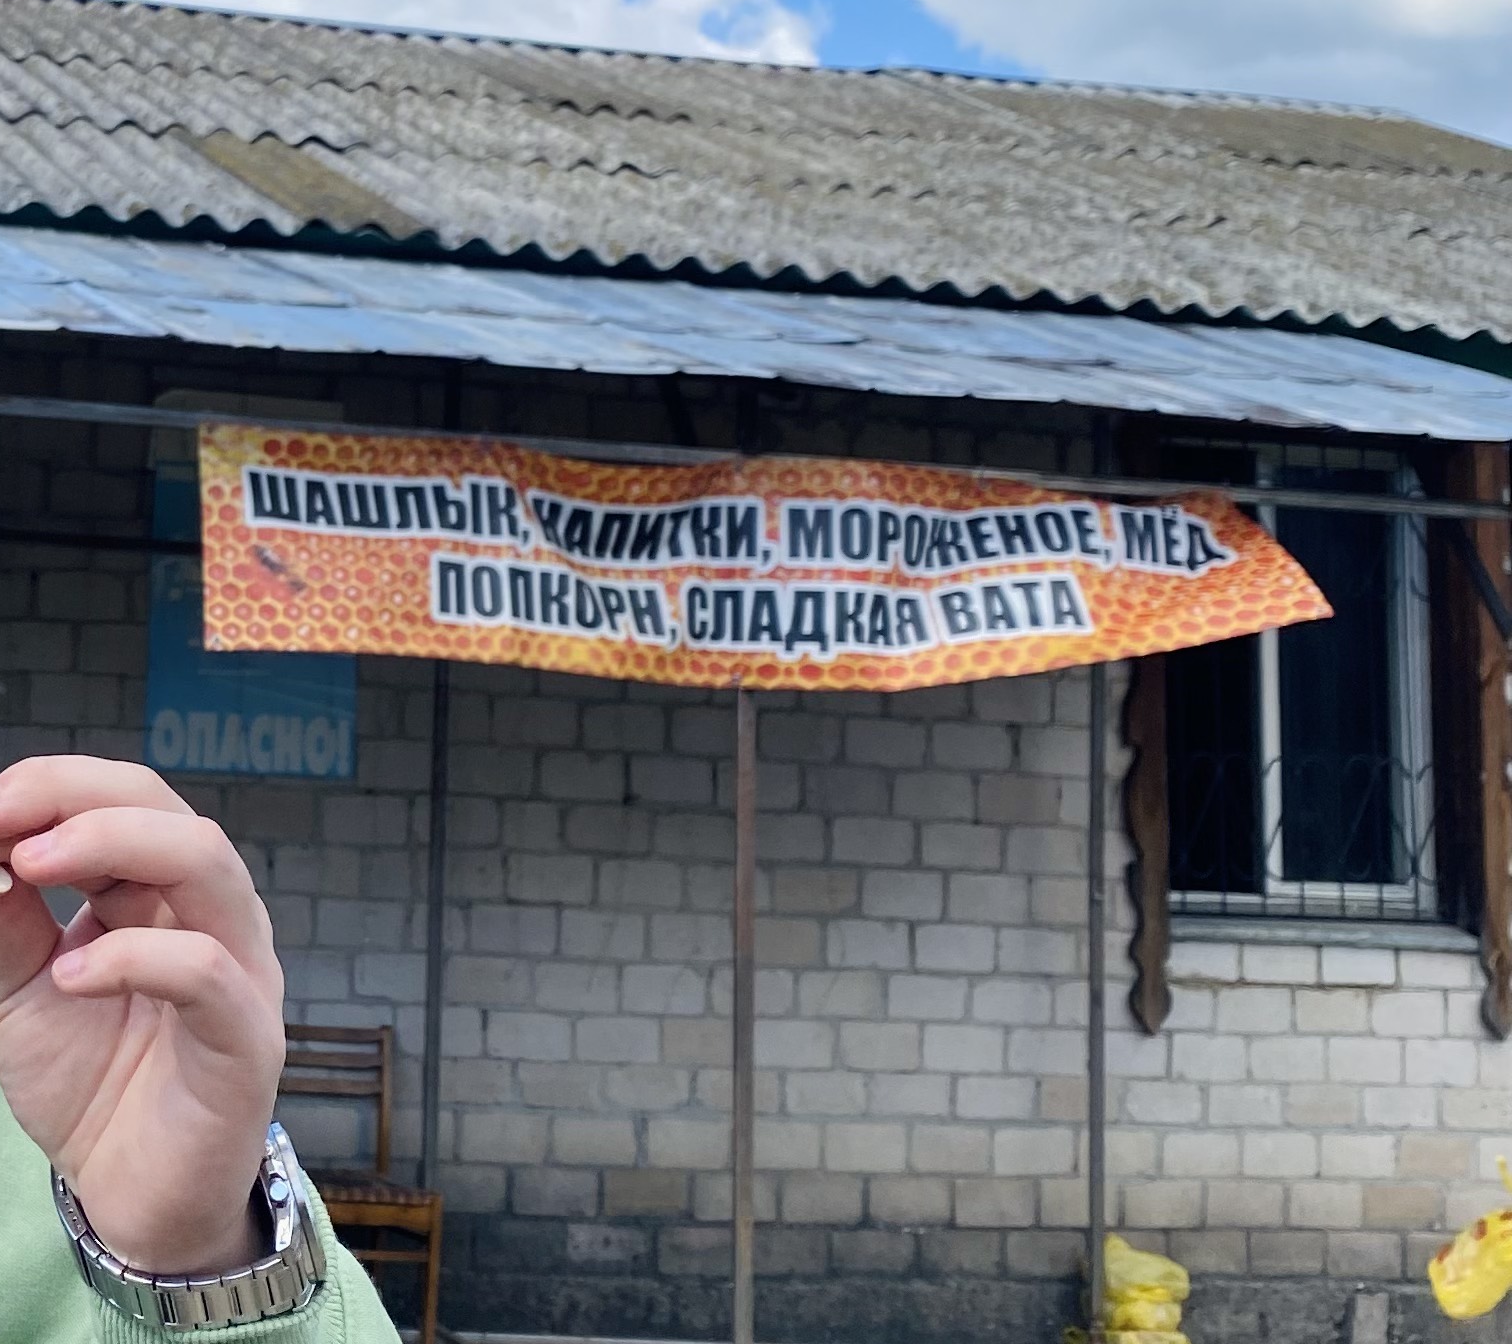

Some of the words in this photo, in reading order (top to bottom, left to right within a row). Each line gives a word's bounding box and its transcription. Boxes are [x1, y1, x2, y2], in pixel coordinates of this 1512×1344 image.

[247, 469, 531, 546] ШАШЛЫК,
[787, 506, 1113, 569] МОРОЖЕНОЕ,
[1119, 506, 1229, 571] МЁД
[436, 560, 677, 643] ПОПКОРН,
[687, 585, 929, 652] СЛАДКАЯ
[938, 578, 1086, 636] ВАТА
[149, 708, 353, 777] ОПАСНО!
